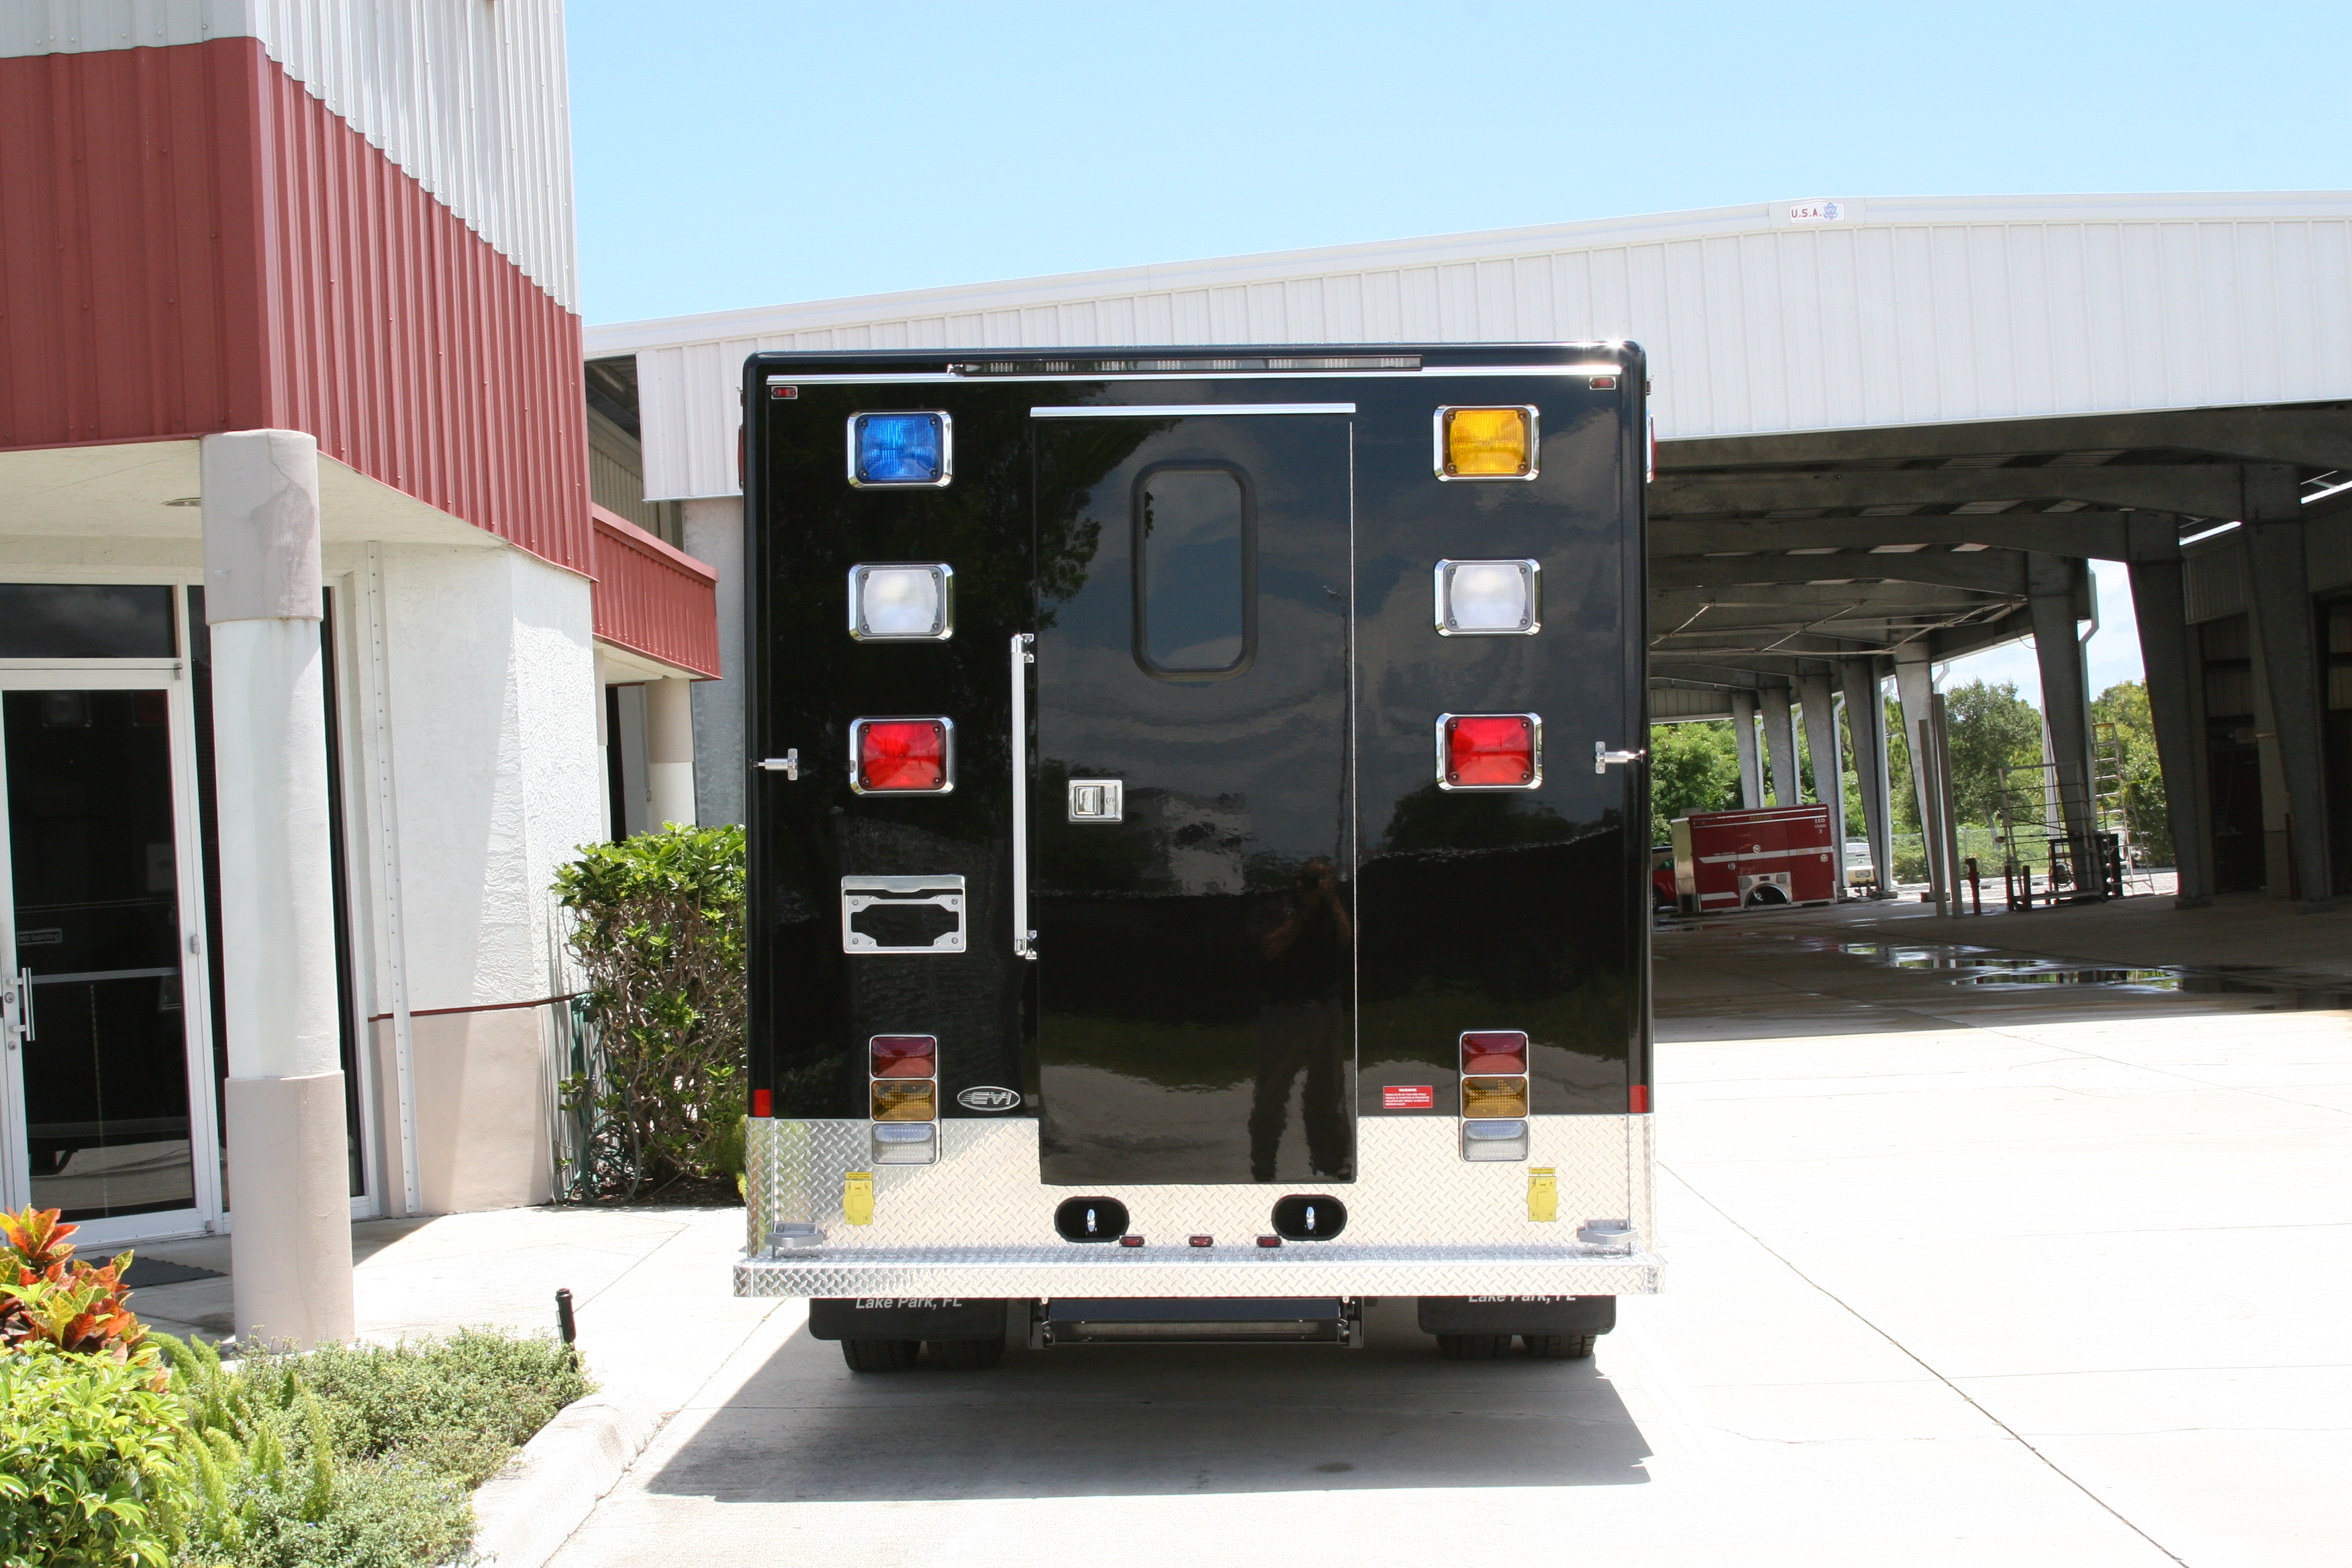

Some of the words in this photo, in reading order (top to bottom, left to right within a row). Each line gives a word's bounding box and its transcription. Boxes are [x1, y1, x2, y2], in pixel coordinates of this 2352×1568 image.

[1791, 207, 1822, 218] U.S.A.
[856, 1298, 893, 1309] Lake
[897, 1298, 937, 1310] Park,
[942, 1298, 963, 1308] FL
